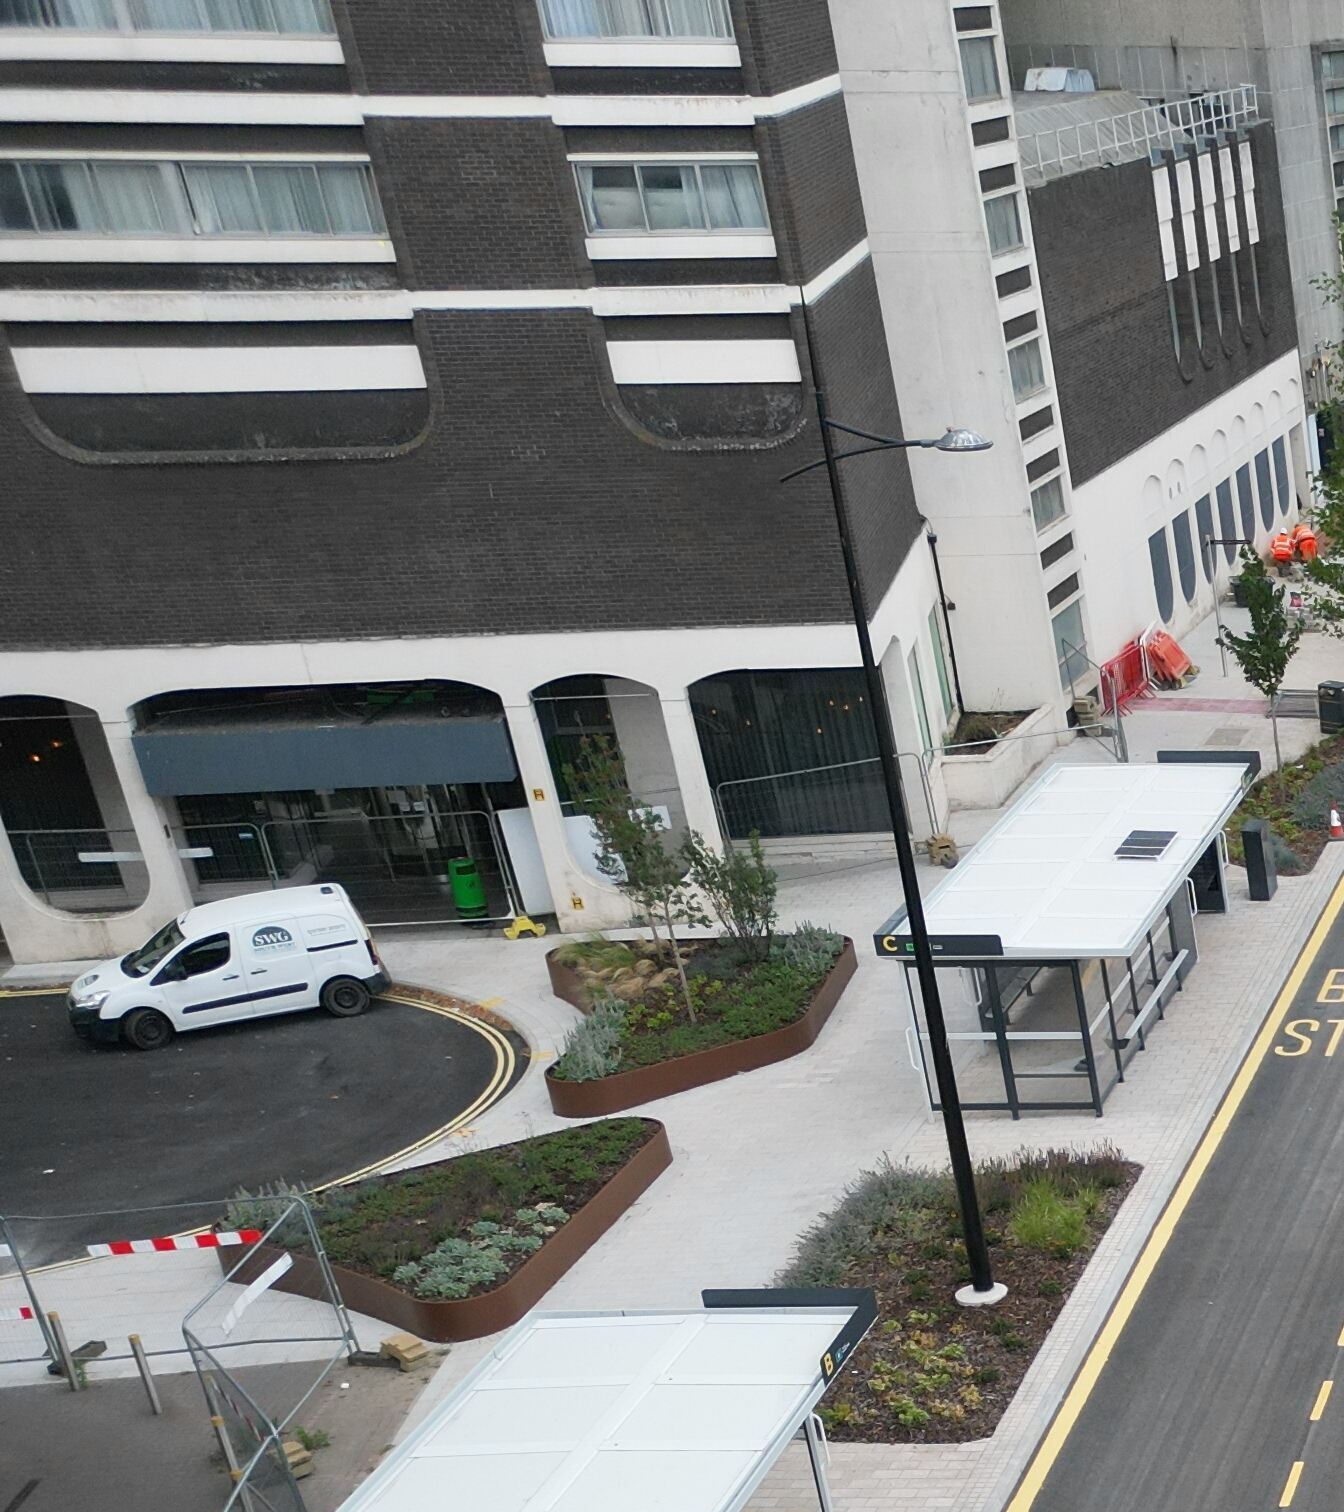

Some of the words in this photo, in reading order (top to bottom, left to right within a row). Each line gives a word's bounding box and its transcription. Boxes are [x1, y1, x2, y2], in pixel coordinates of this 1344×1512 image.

[254, 930, 289, 946] SWG
[883, 935, 898, 952] C
[823, 1352, 834, 1377] B
